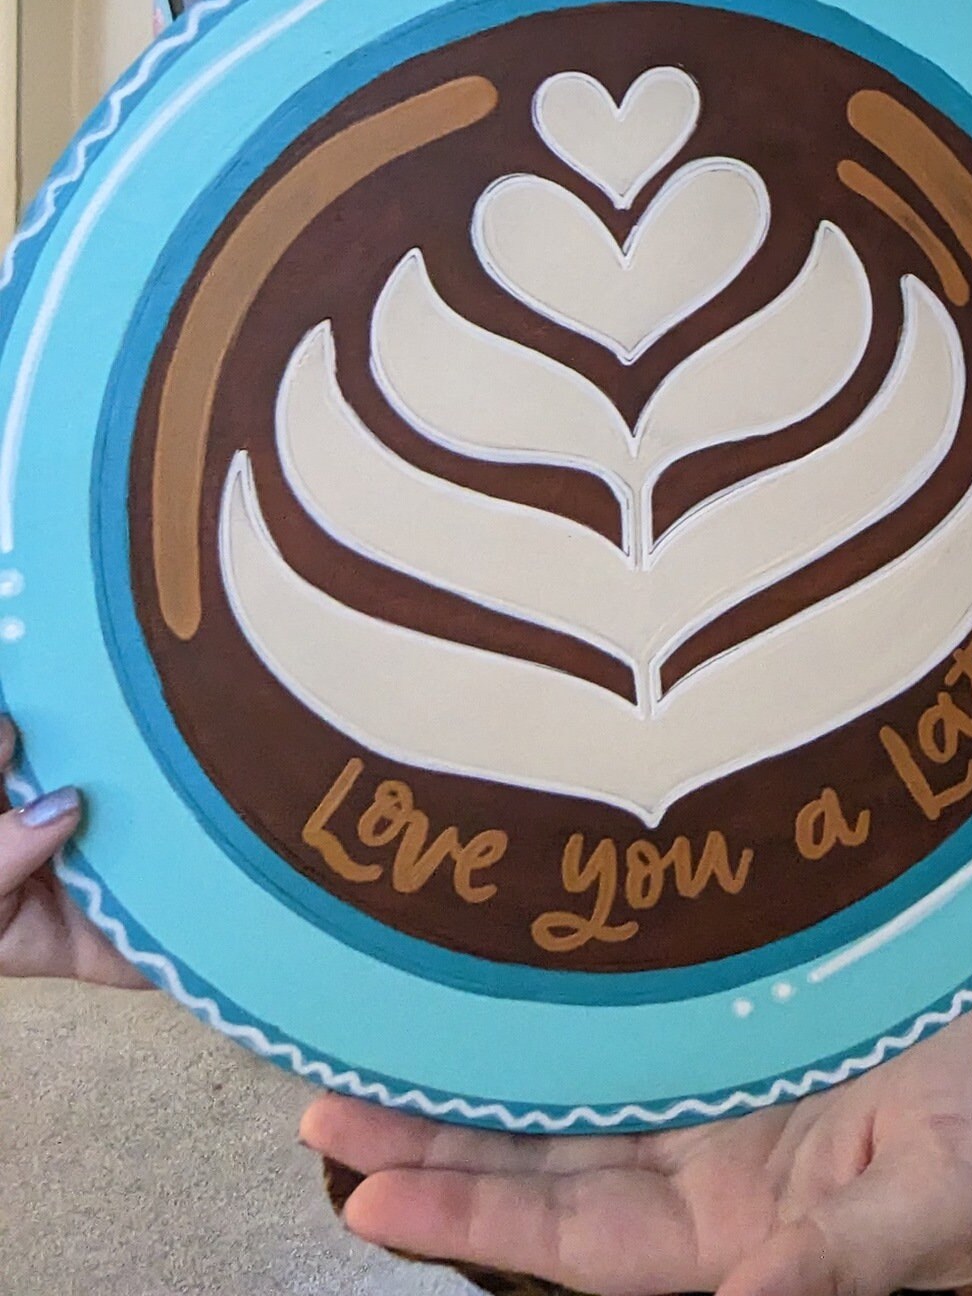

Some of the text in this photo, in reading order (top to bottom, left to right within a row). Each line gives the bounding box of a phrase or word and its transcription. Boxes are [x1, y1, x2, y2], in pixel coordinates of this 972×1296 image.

[303, 758, 508, 902] Love
[531, 830, 754, 952] you
[796, 787, 870, 860] a
